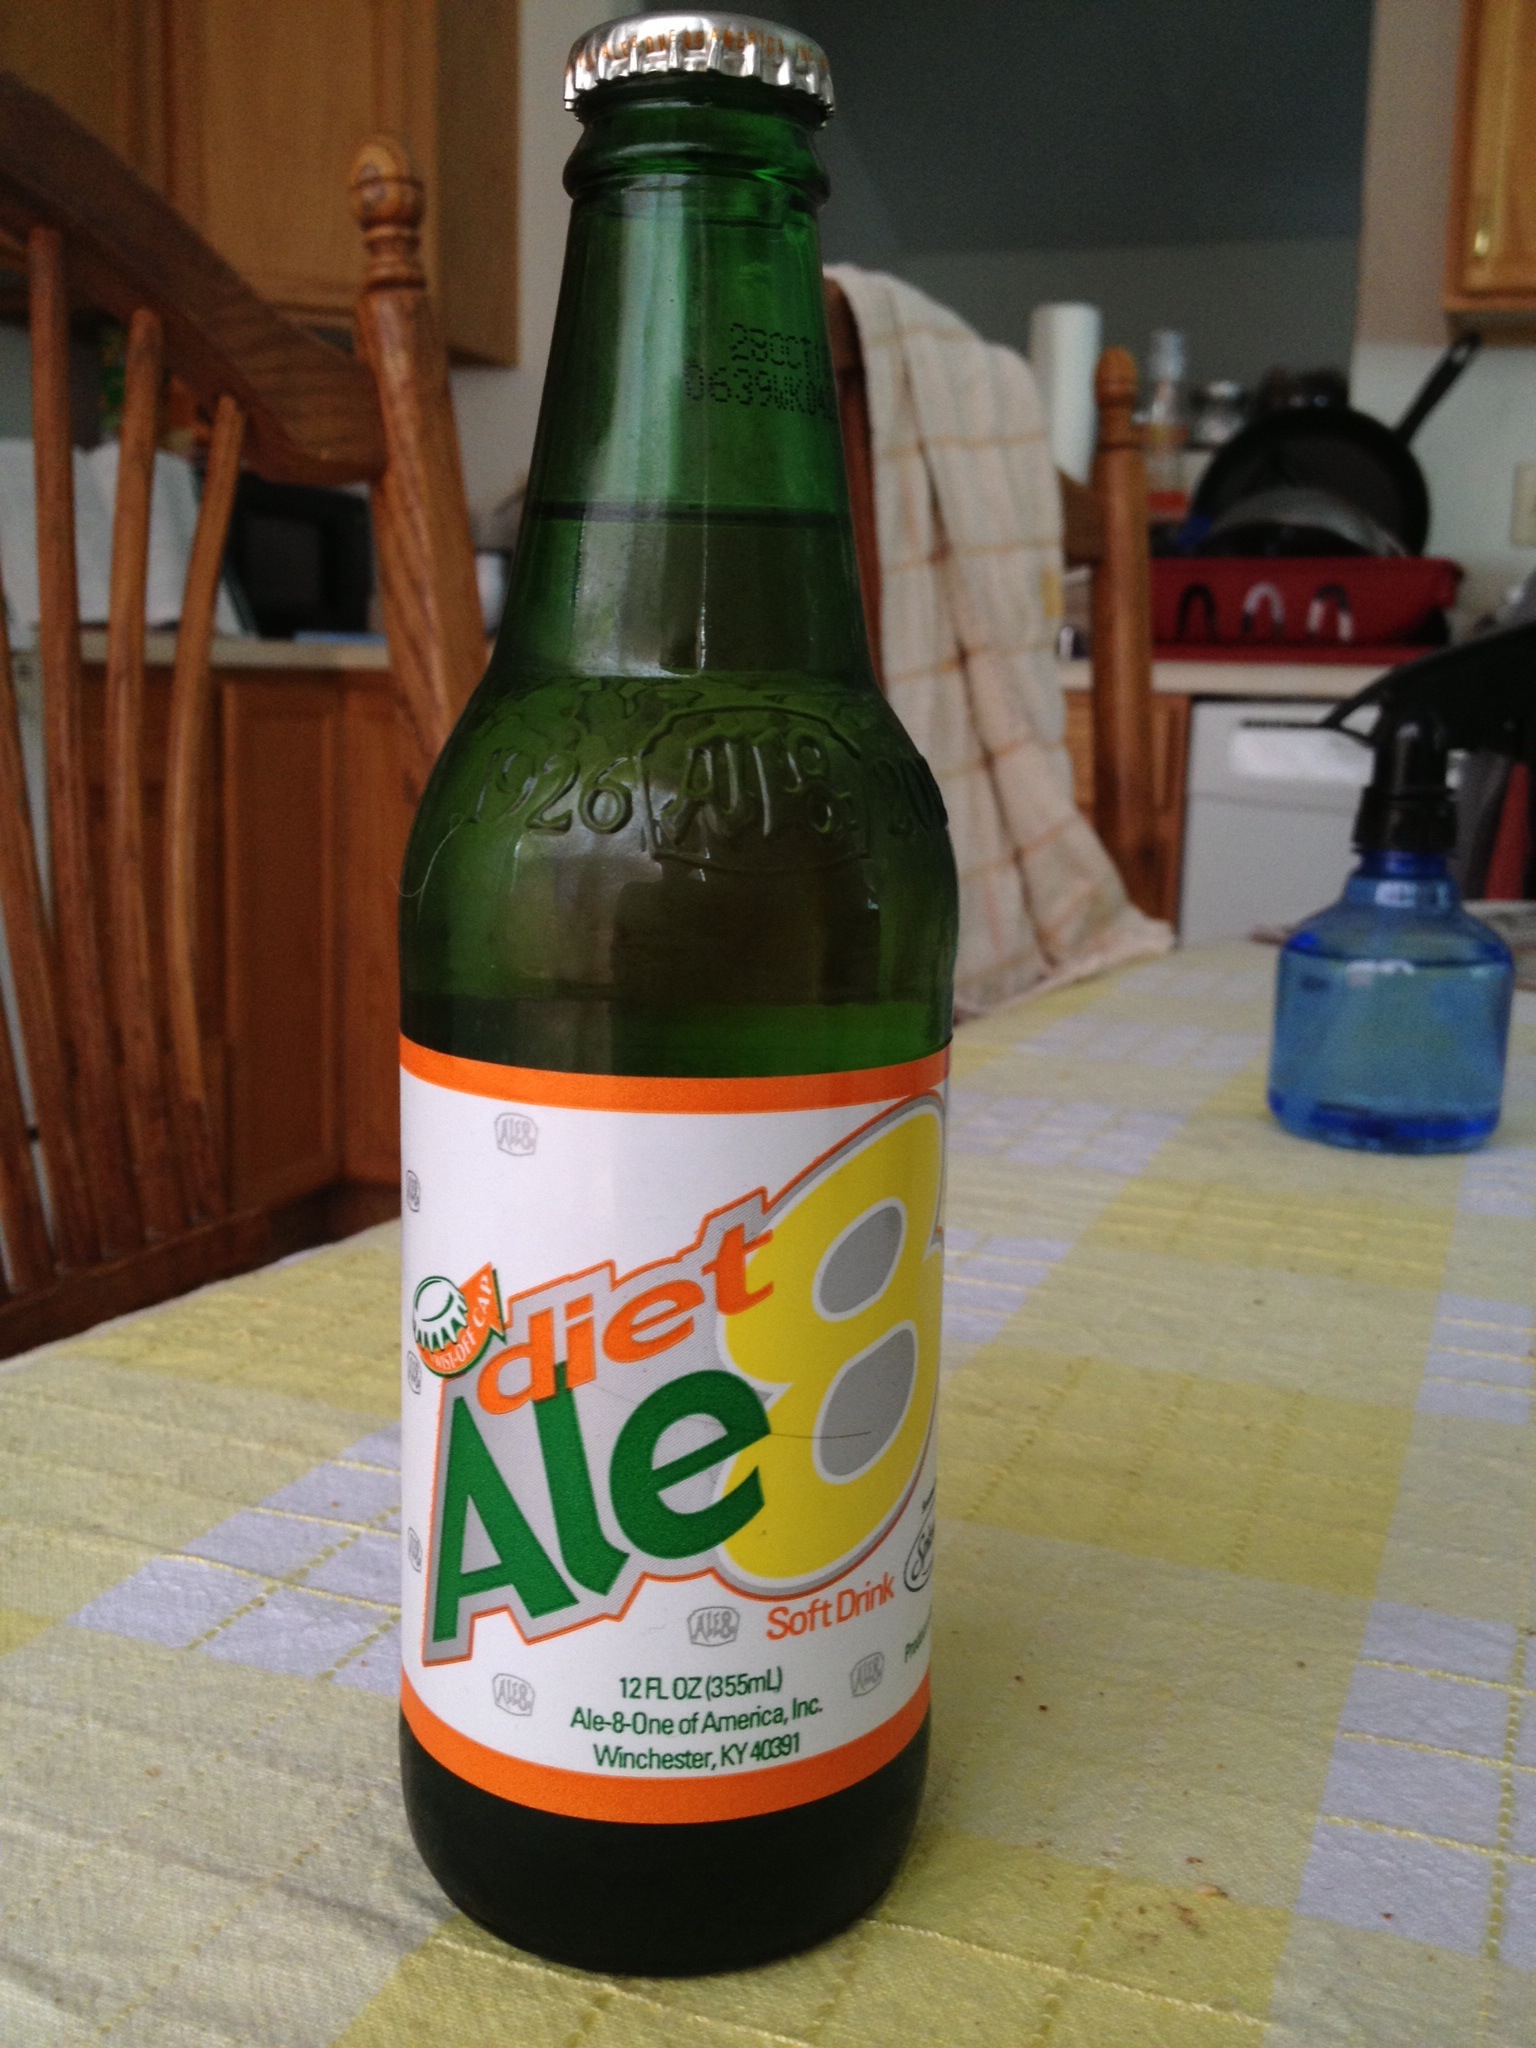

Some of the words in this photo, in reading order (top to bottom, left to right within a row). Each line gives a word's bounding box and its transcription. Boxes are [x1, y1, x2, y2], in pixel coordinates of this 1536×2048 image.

[466, 748, 633, 836] 1926
[471, 1275, 492, 1328] CAP
[477, 1222, 774, 1415] diet
[432, 1361, 772, 1644] Ale
[766, 1598, 832, 1640] Soft
[836, 1571, 895, 1624] Drink
[619, 1676, 641, 1700] 12
[645, 1676, 670, 1700] FL
[672, 1676, 703, 1700] OZ
[705, 1665, 783, 1702] (355mL)
[570, 1706, 674, 1735] Ale-8-One
[678, 1711, 699, 1735] of
[701, 1704, 789, 1734] America,
[792, 1697, 824, 1721] Inc.
[593, 1743, 717, 1771] Winchester,
[721, 1741, 749, 1767] KY
[750, 1731, 800, 1762] 40391
